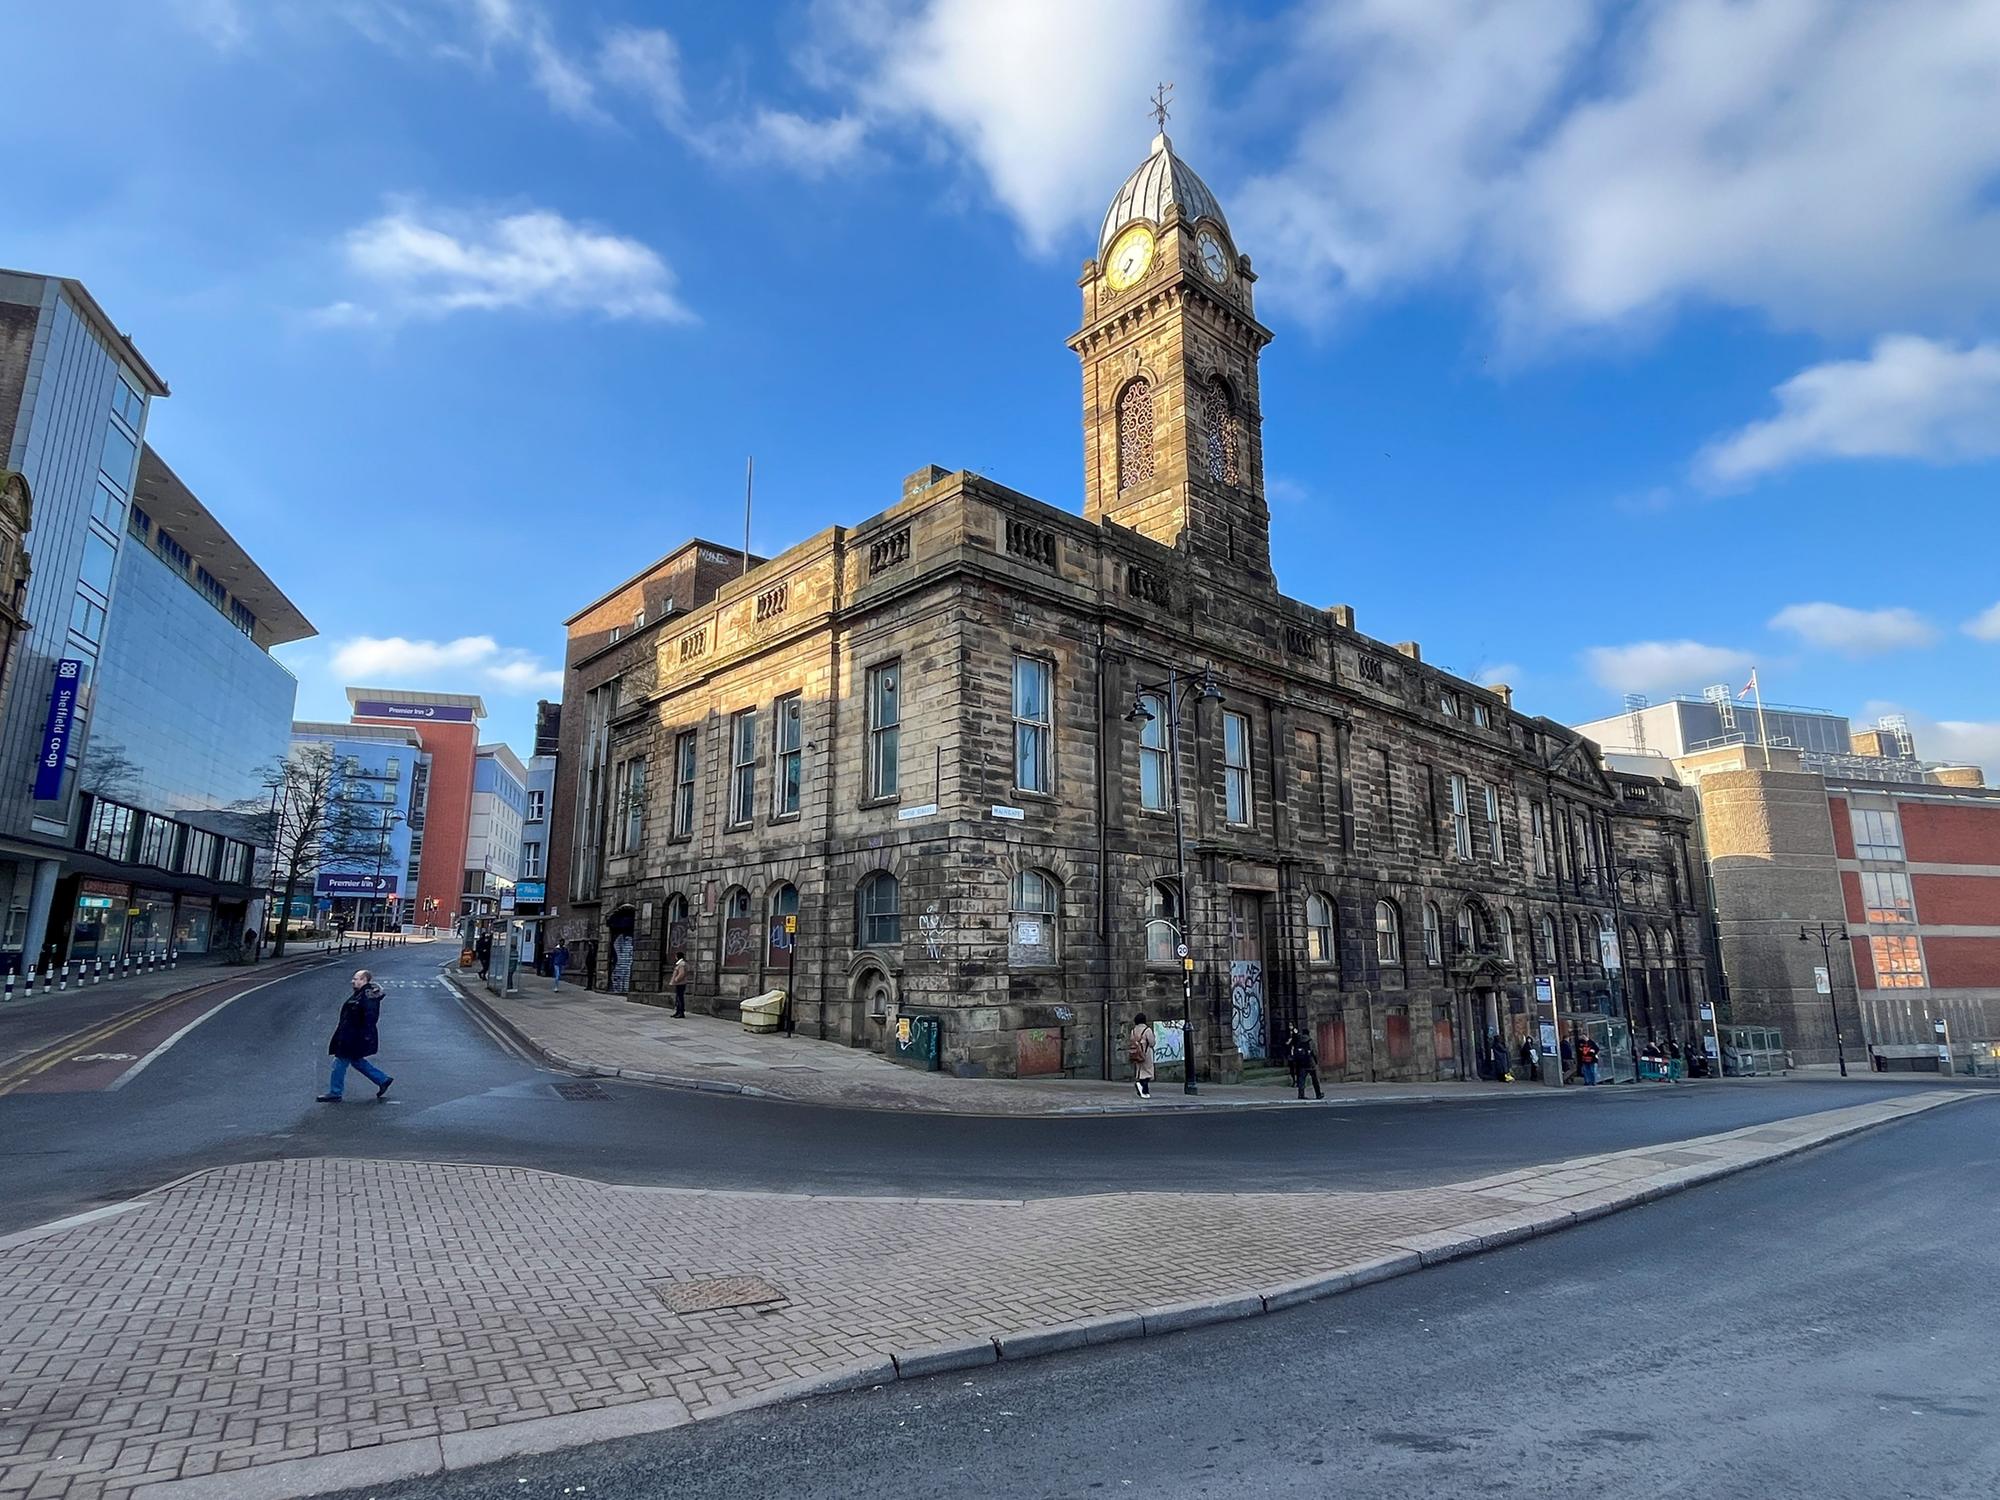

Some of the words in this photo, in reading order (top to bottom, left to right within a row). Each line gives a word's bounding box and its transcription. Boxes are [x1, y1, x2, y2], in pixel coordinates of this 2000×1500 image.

[53, 690, 71, 734] Sheffield
[388, 706, 413, 715] Premier
[329, 878, 360, 888] Premier
[361, 880, 374, 888] Inn
[1178, 946, 1188, 954] 20
